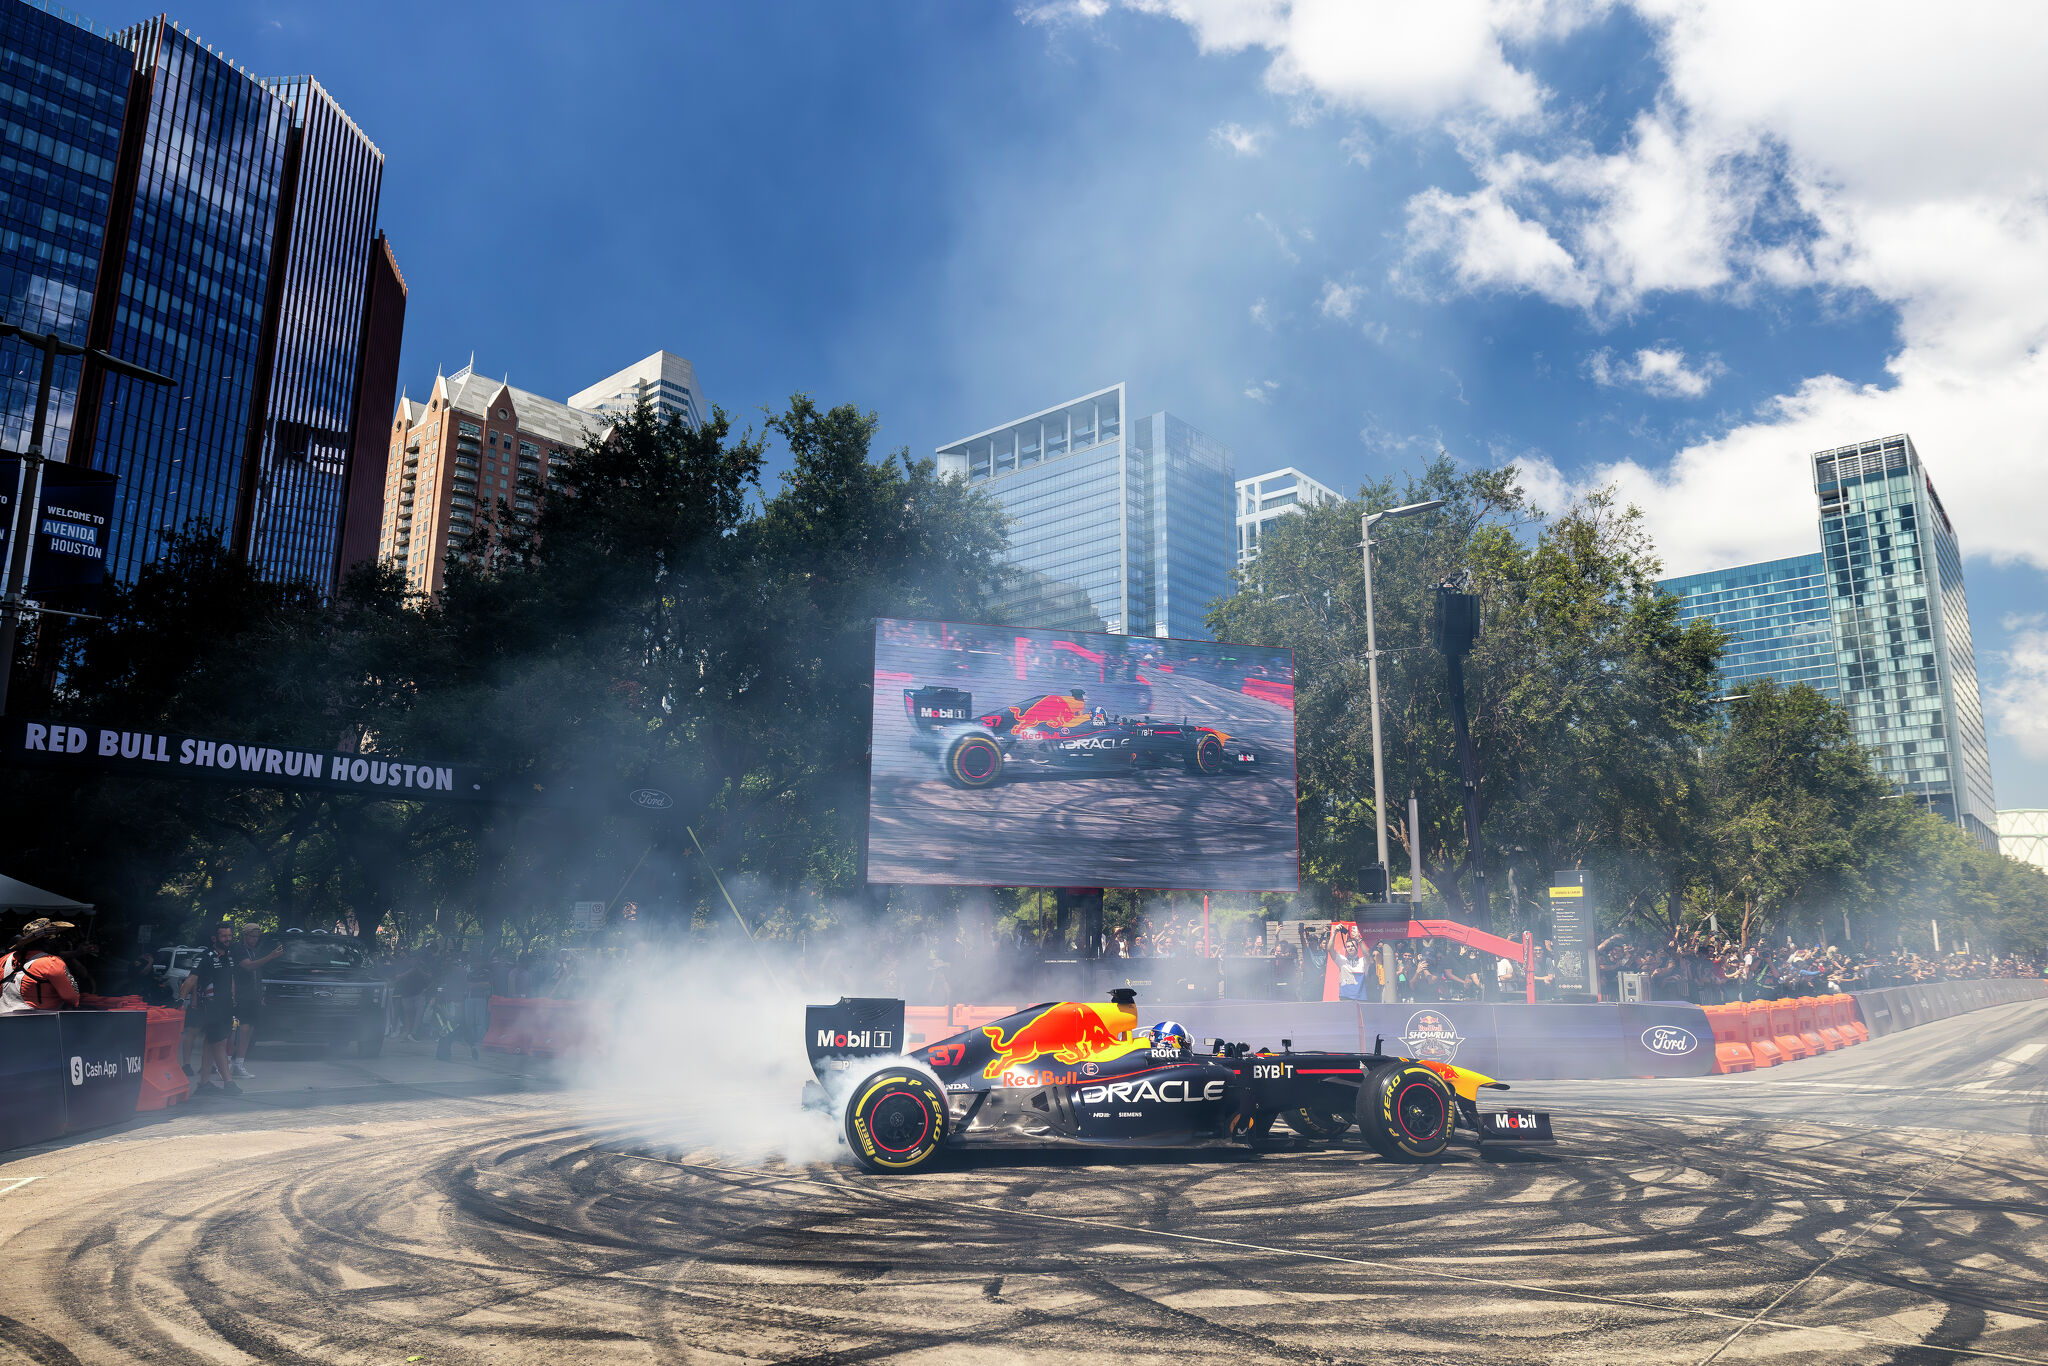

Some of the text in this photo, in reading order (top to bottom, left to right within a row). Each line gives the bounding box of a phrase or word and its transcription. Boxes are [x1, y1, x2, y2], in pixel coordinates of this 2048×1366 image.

[47, 505, 105, 525] WELCOME TO
[43, 521, 95, 543] AVENIDA
[51, 537, 102, 559] HOUSTON
[920, 707, 954, 719] Mobil
[980, 715, 1002, 727] 37
[1022, 731, 1040, 740] Red
[1058, 738, 1130, 750] ORACLE
[24, 722, 454, 791] RED BULL SHOWRUN HOUSTON
[817, 1029, 871, 1048] Mobil
[1408, 1031, 1455, 1040] SHOWRUN
[1653, 1029, 1688, 1051] Ford
[928, 1043, 966, 1067] 37
[1151, 1049, 1181, 1058] ROKT
[85, 1060, 103, 1078] Cash
[103, 1060, 118, 1078] App
[126, 1056, 141, 1073] VISA
[1253, 1061, 1294, 1079] BYBIT
[1003, 1069, 1078, 1088] Red Bull
[1071, 1080, 1226, 1104] ORACLE
[923, 1089, 943, 1142] ZERO
[1383, 1074, 1401, 1137] P ZERO
[1495, 1113, 1537, 1129] Mobil
[854, 1117, 876, 1157] PIRELLI
